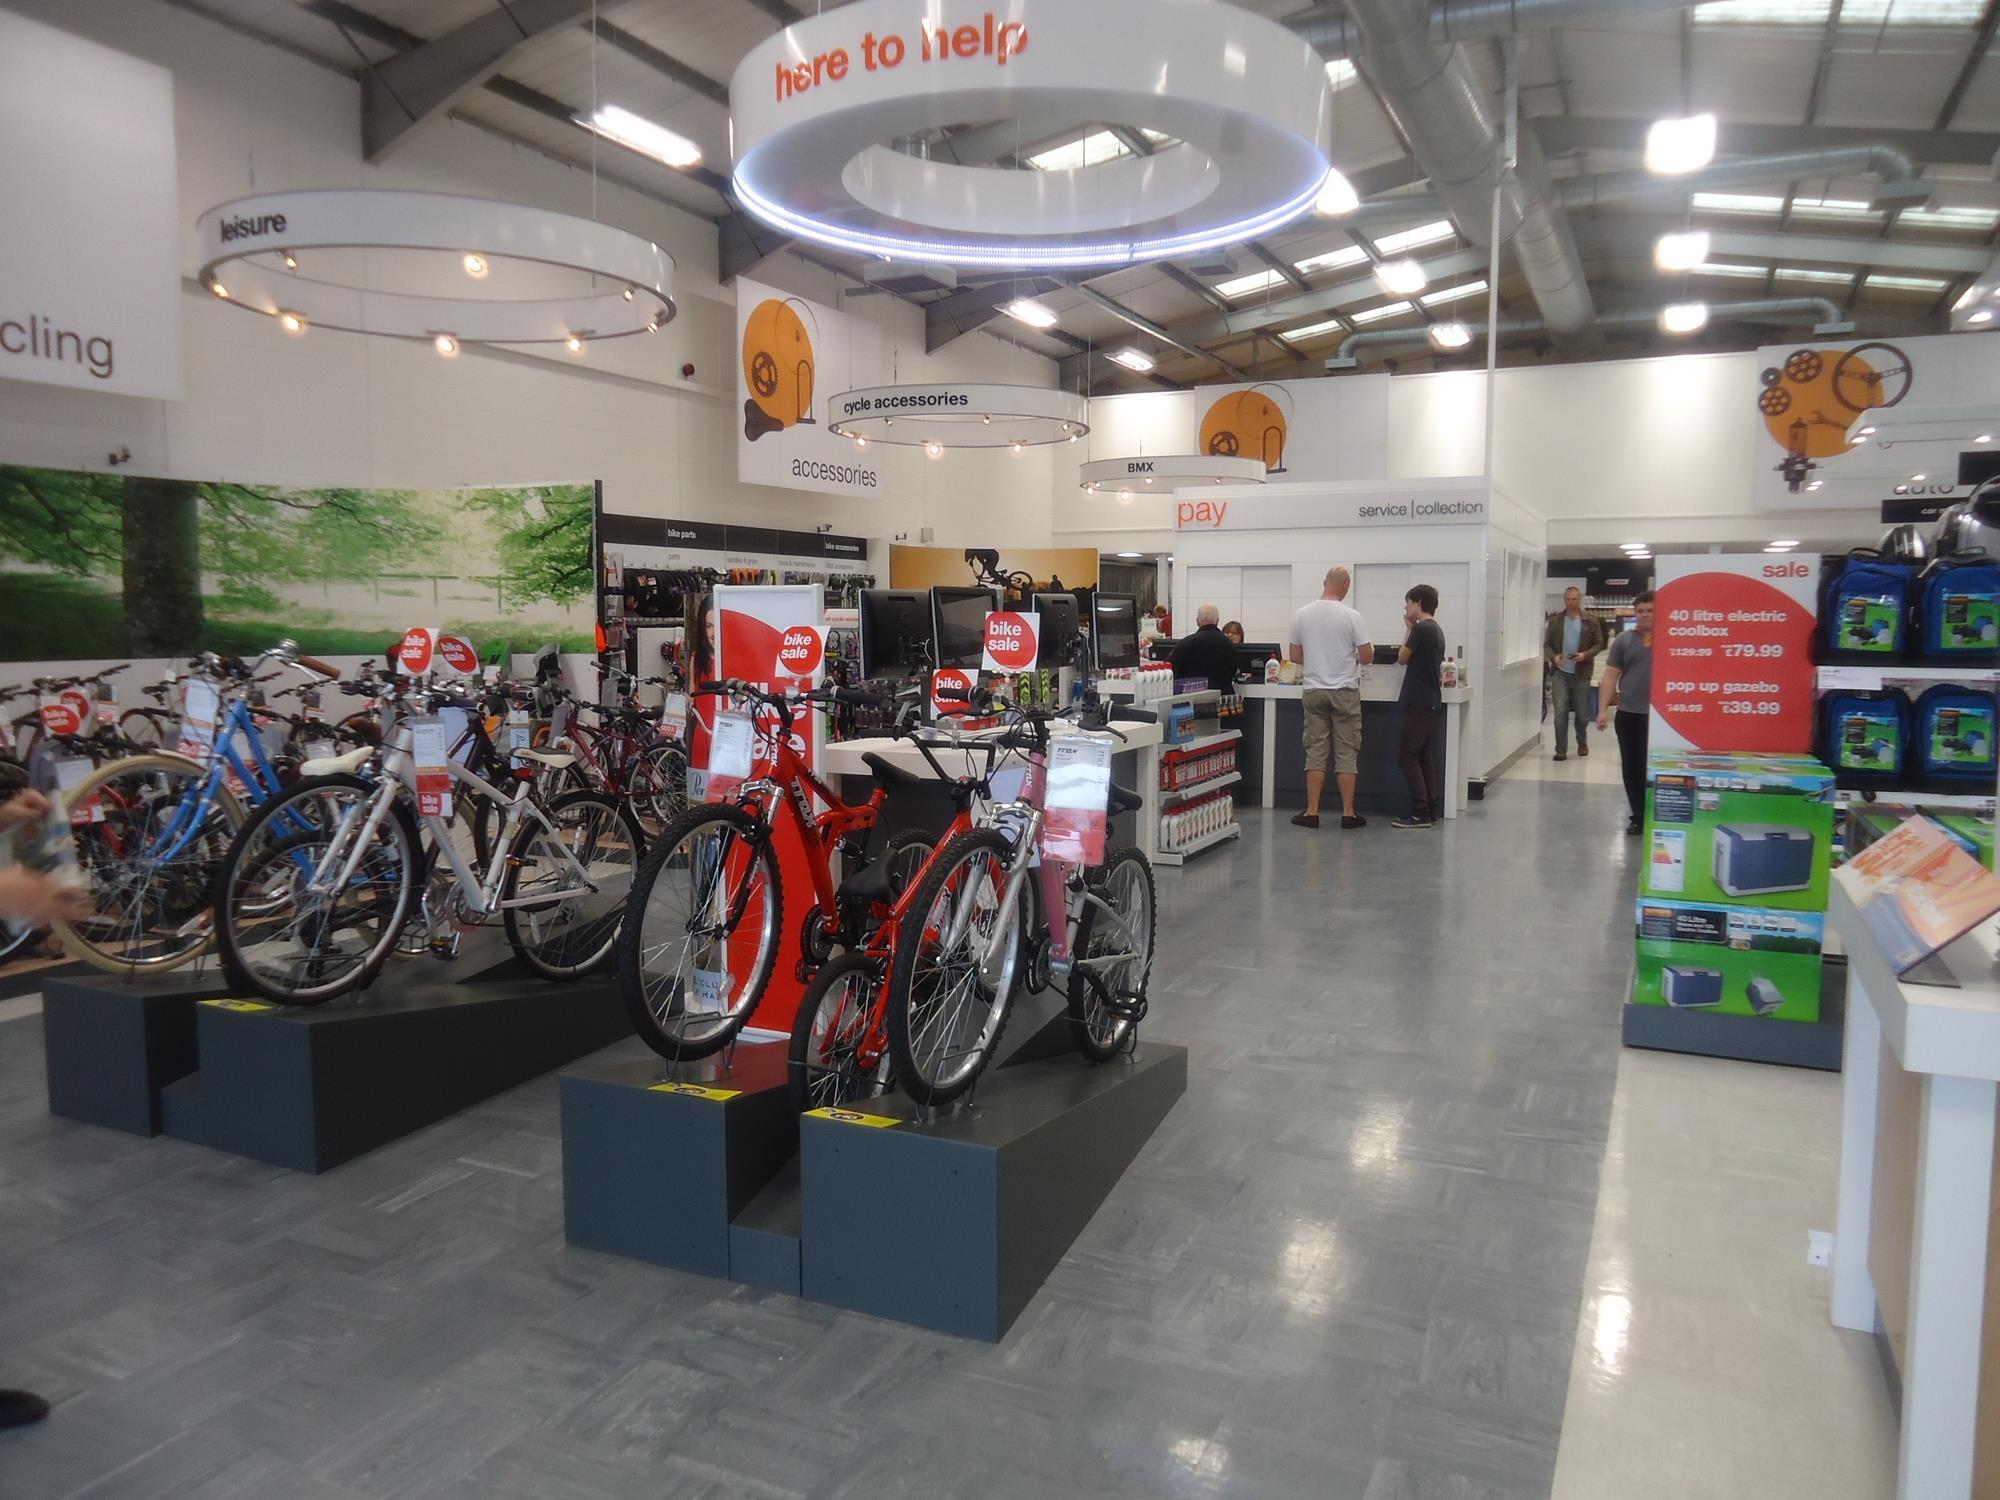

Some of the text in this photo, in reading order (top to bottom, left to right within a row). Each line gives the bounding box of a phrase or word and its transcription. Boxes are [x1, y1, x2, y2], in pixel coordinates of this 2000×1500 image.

[775, 12, 1028, 103] here to help
[221, 214, 287, 243] leisure
[0, 313, 113, 379] cling
[844, 391, 968, 415] cycle accessories
[792, 457, 877, 488] accessories
[1127, 462, 1154, 473] BMX
[1177, 500, 1228, 529] pay
[1358, 500, 1483, 517] service collection
[667, 528, 696, 540] bike parts
[1762, 561, 1809, 578] sale
[1669, 609, 1787, 622] 40 litre electric
[989, 620, 1022, 636] bike
[1668, 624, 1729, 637] coolbox
[404, 634, 426, 647] bike
[783, 633, 813, 646] bike
[988, 637, 1020, 651] sale
[401, 647, 423, 659] sale
[440, 642, 463, 652] bike
[780, 646, 808, 659] sale
[445, 652, 466, 661] sale
[935, 677, 963, 690] bike
[1666, 680, 1779, 694] pop up gazebo
